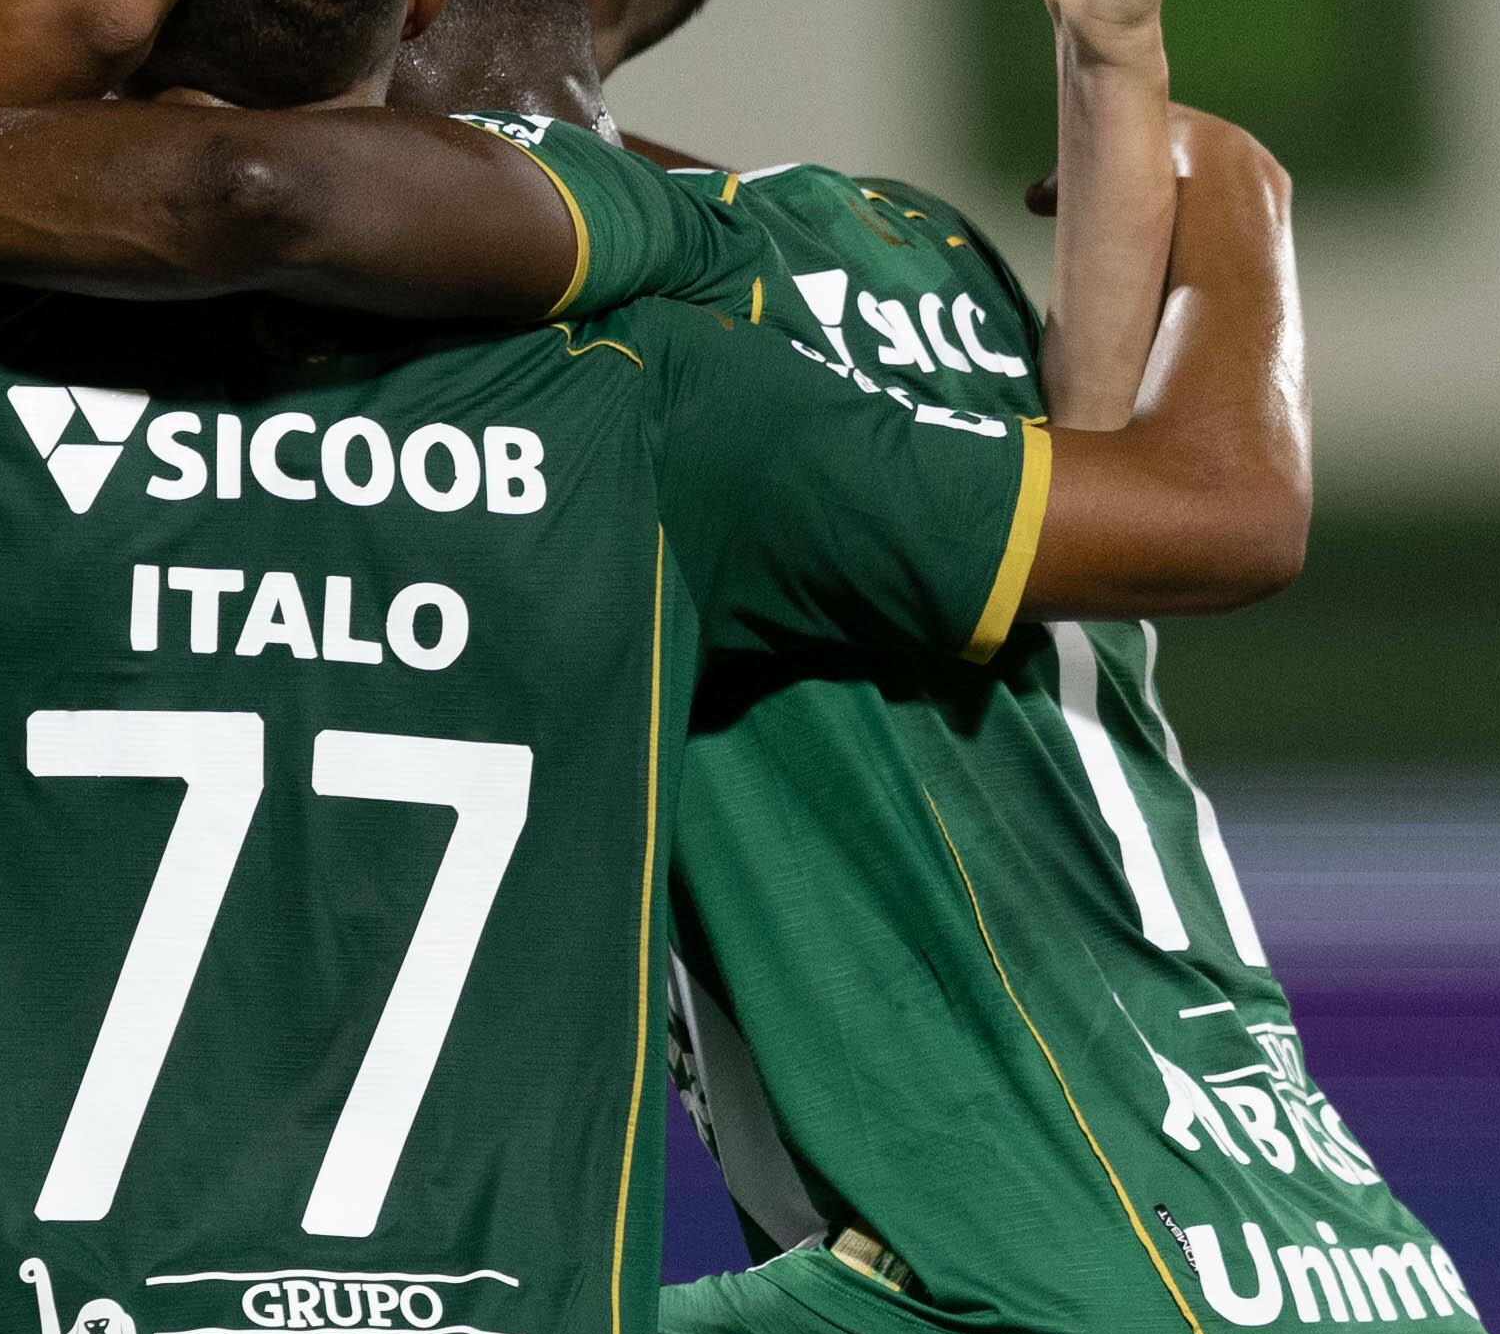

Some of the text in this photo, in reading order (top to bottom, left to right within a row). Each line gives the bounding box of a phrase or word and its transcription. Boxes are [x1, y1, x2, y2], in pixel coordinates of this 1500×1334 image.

[144, 411, 548, 515] SICOOB
[129, 563, 471, 672] ITALO
[25, 709, 535, 1238] 77
[241, 1279, 444, 1330] GRUPO
[1182, 1219, 1482, 1327] Unime
